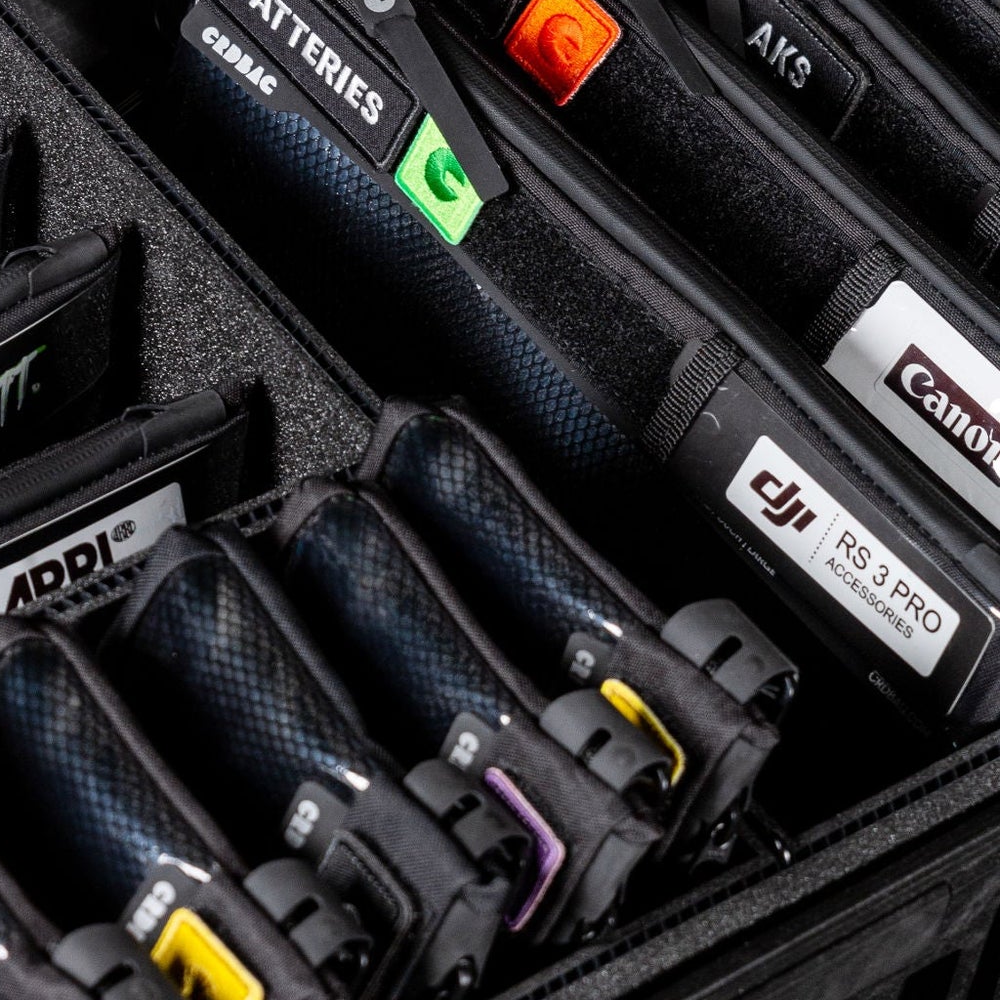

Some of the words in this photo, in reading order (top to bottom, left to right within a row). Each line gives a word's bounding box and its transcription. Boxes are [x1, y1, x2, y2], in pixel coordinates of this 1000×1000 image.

[201, 26, 279, 97] CRDBAG
[747, 21, 812, 90] AKS
[825, 557, 915, 639] ACCESSORIES
[836, 530, 872, 570] RS
[872, 564, 890, 587] 3
[890, 579, 943, 634] PRO
